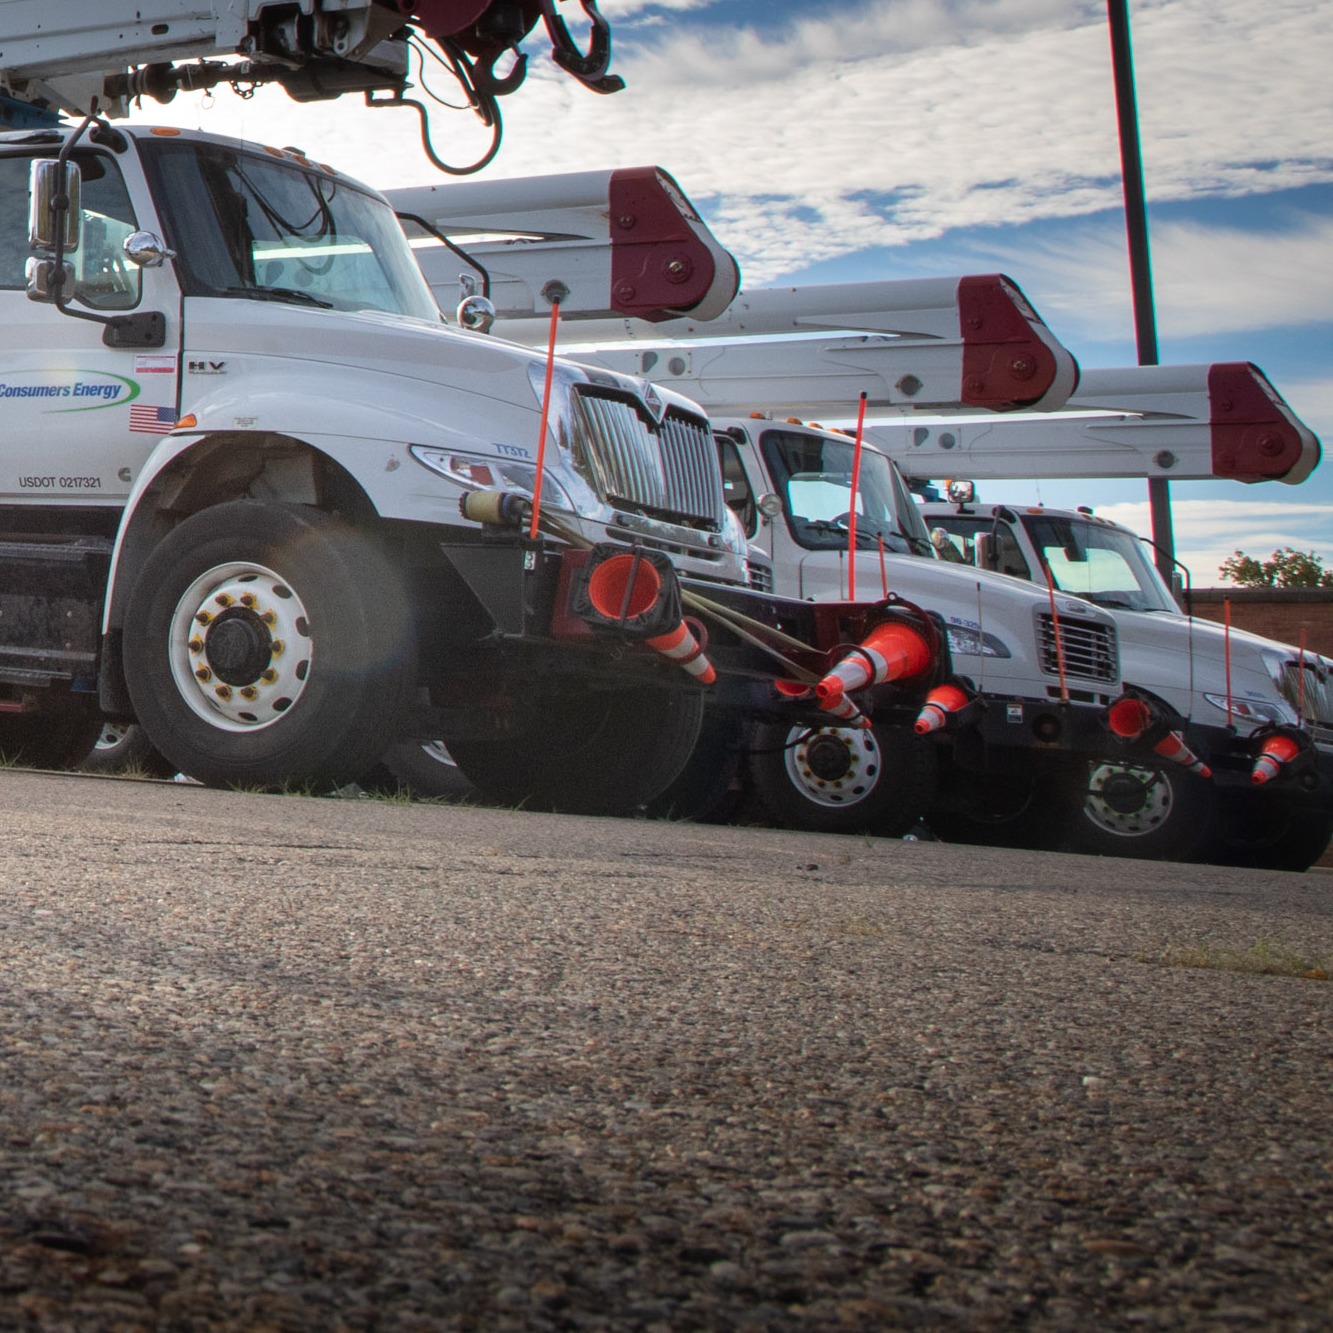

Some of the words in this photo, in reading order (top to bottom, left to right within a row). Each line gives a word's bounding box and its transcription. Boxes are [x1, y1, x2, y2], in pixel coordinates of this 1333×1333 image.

[189, 361, 226, 370] HV
[72, 382, 122, 399] Energy
[19, 476, 56, 487] USDOT
[59, 476, 101, 488] 0217321
